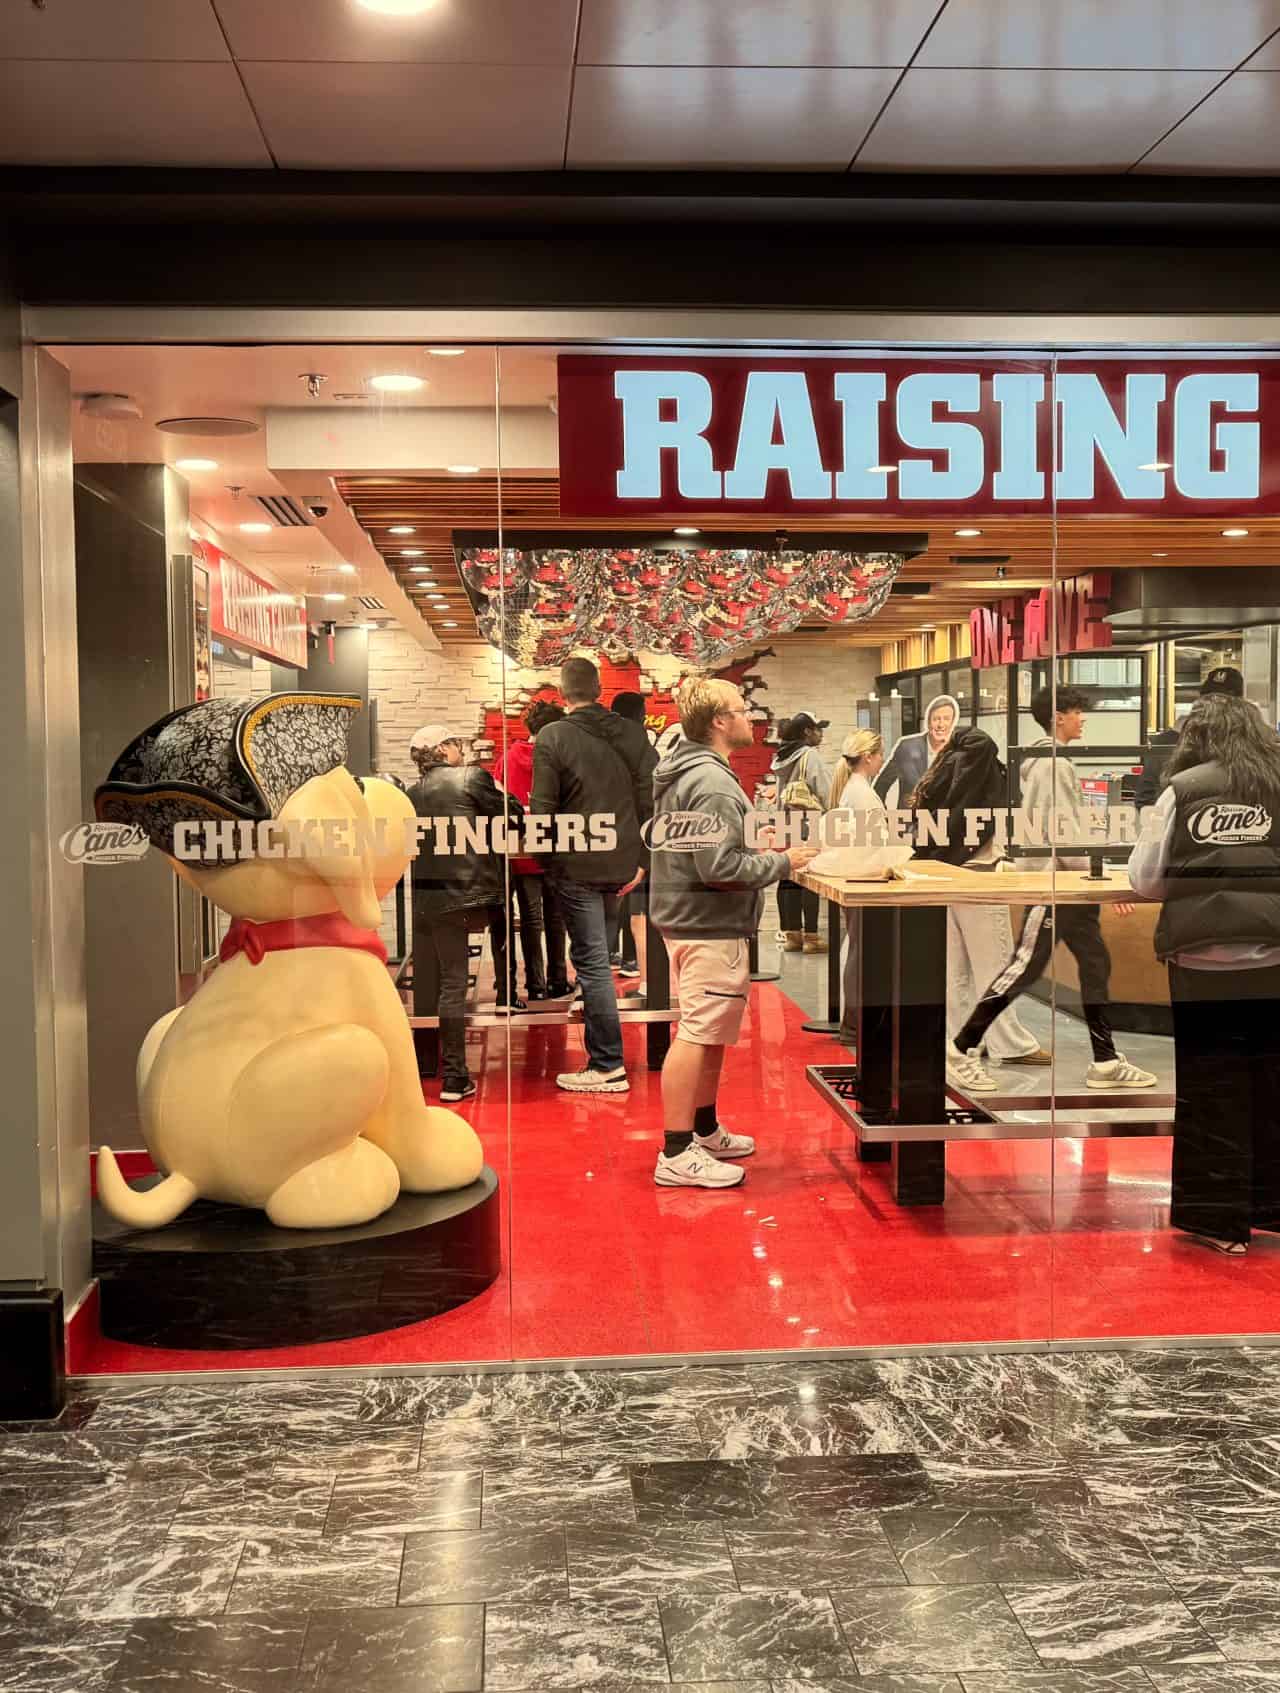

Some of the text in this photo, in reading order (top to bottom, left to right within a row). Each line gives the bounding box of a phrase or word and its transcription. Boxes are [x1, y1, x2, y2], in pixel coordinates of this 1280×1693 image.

[613, 369, 1261, 500] RAISING
[970, 599, 1018, 669] ONE
[64, 823, 150, 862] Cane's
[173, 813, 618, 860] CHICKEN FINGERS
[644, 811, 727, 850] Cane's
[744, 805, 1165, 848] CHICKEN FINGERS
[1192, 803, 1269, 841] Cane's
